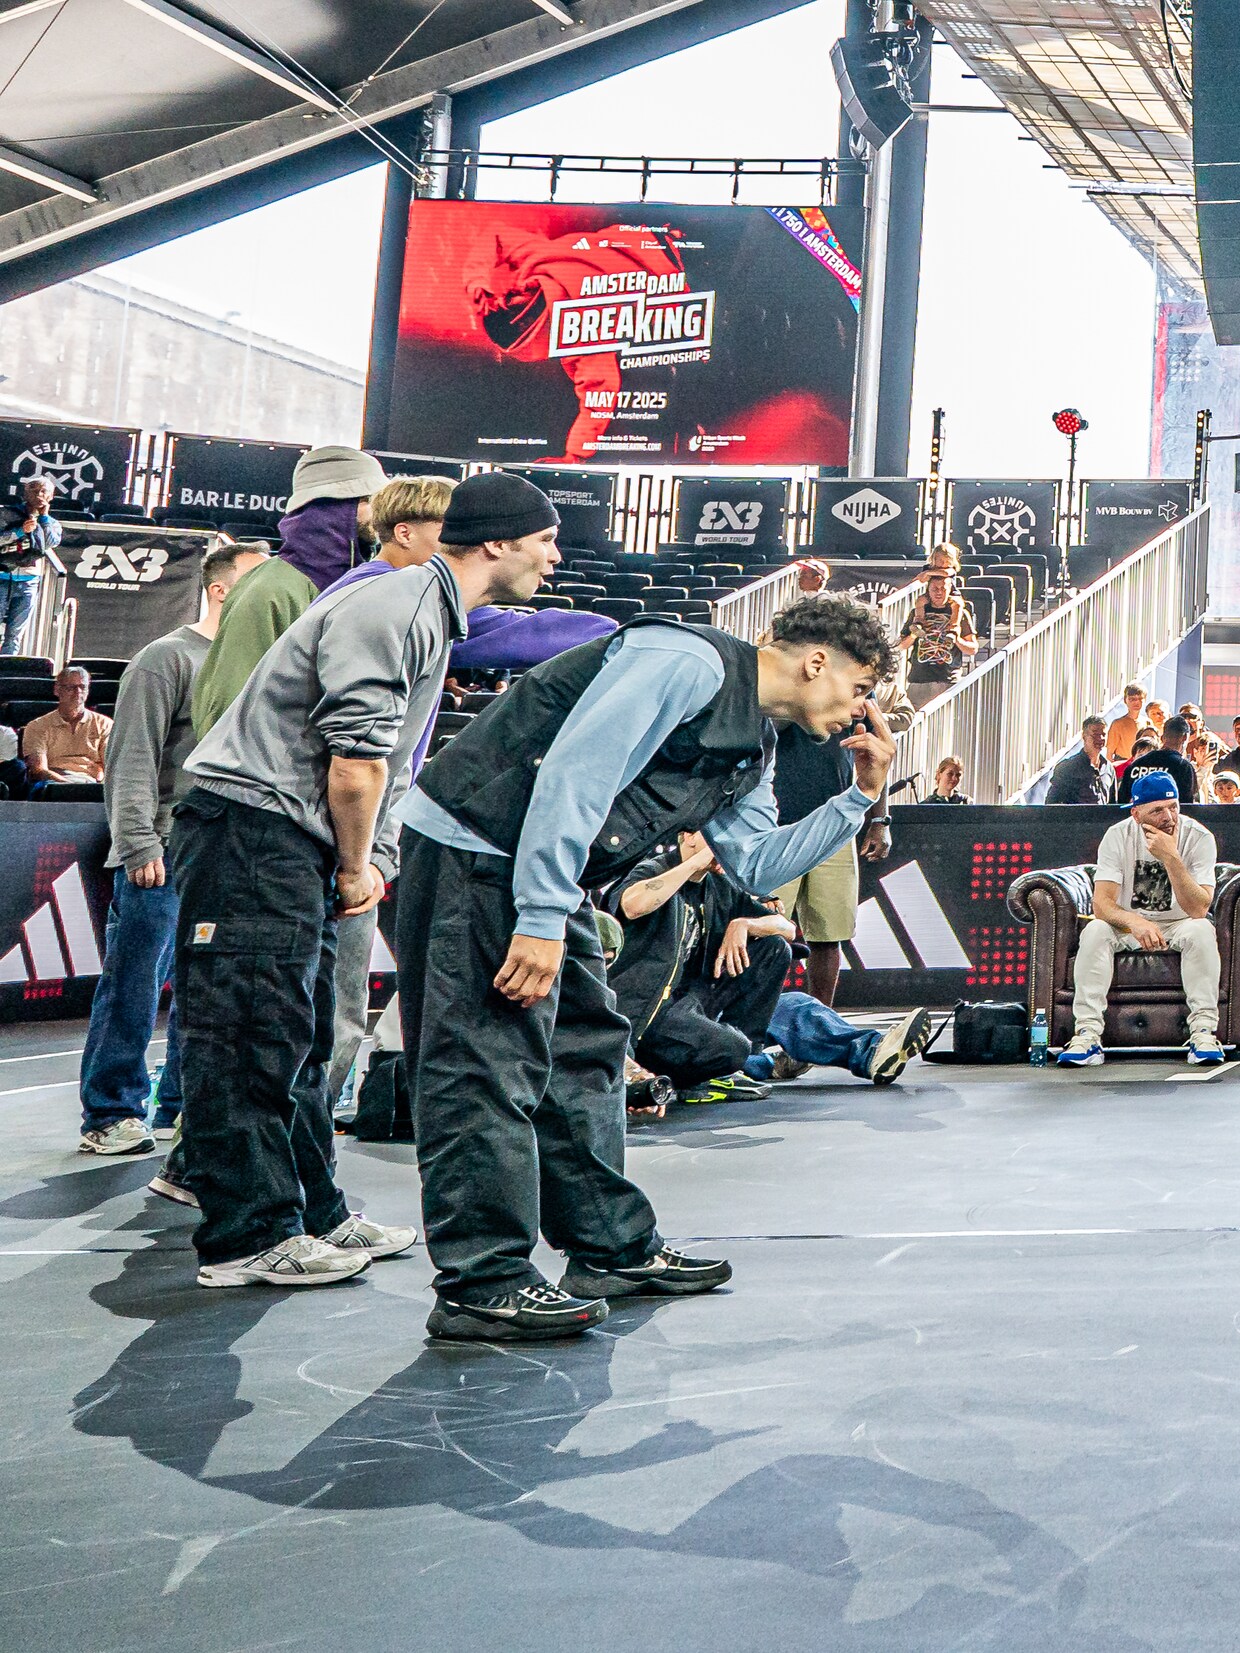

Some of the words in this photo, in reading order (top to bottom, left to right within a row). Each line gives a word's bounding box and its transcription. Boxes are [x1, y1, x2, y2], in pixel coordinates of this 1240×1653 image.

[780, 211, 803, 233] 750
[802, 233, 862, 289] AMSTERDAM
[580, 271, 686, 296] AMSTERDAM
[562, 303, 703, 345] BREAKING
[620, 349, 711, 370] CHAMPIONSHIPS
[585, 391, 615, 408] MAY
[616, 391, 632, 408] 17
[632, 391, 668, 409] 2025
[32, 442, 89, 459] UNITES
[548, 490, 594, 499] TOPSPORT
[549, 497, 600, 507] AMSTERDAM
[981, 496, 1025, 510] UNITES
[843, 502, 891, 525] NIJHA
[1095, 506, 1118, 515] MVB
[86, 581, 117, 590] WORLD
[117, 582, 141, 592] TOUR
